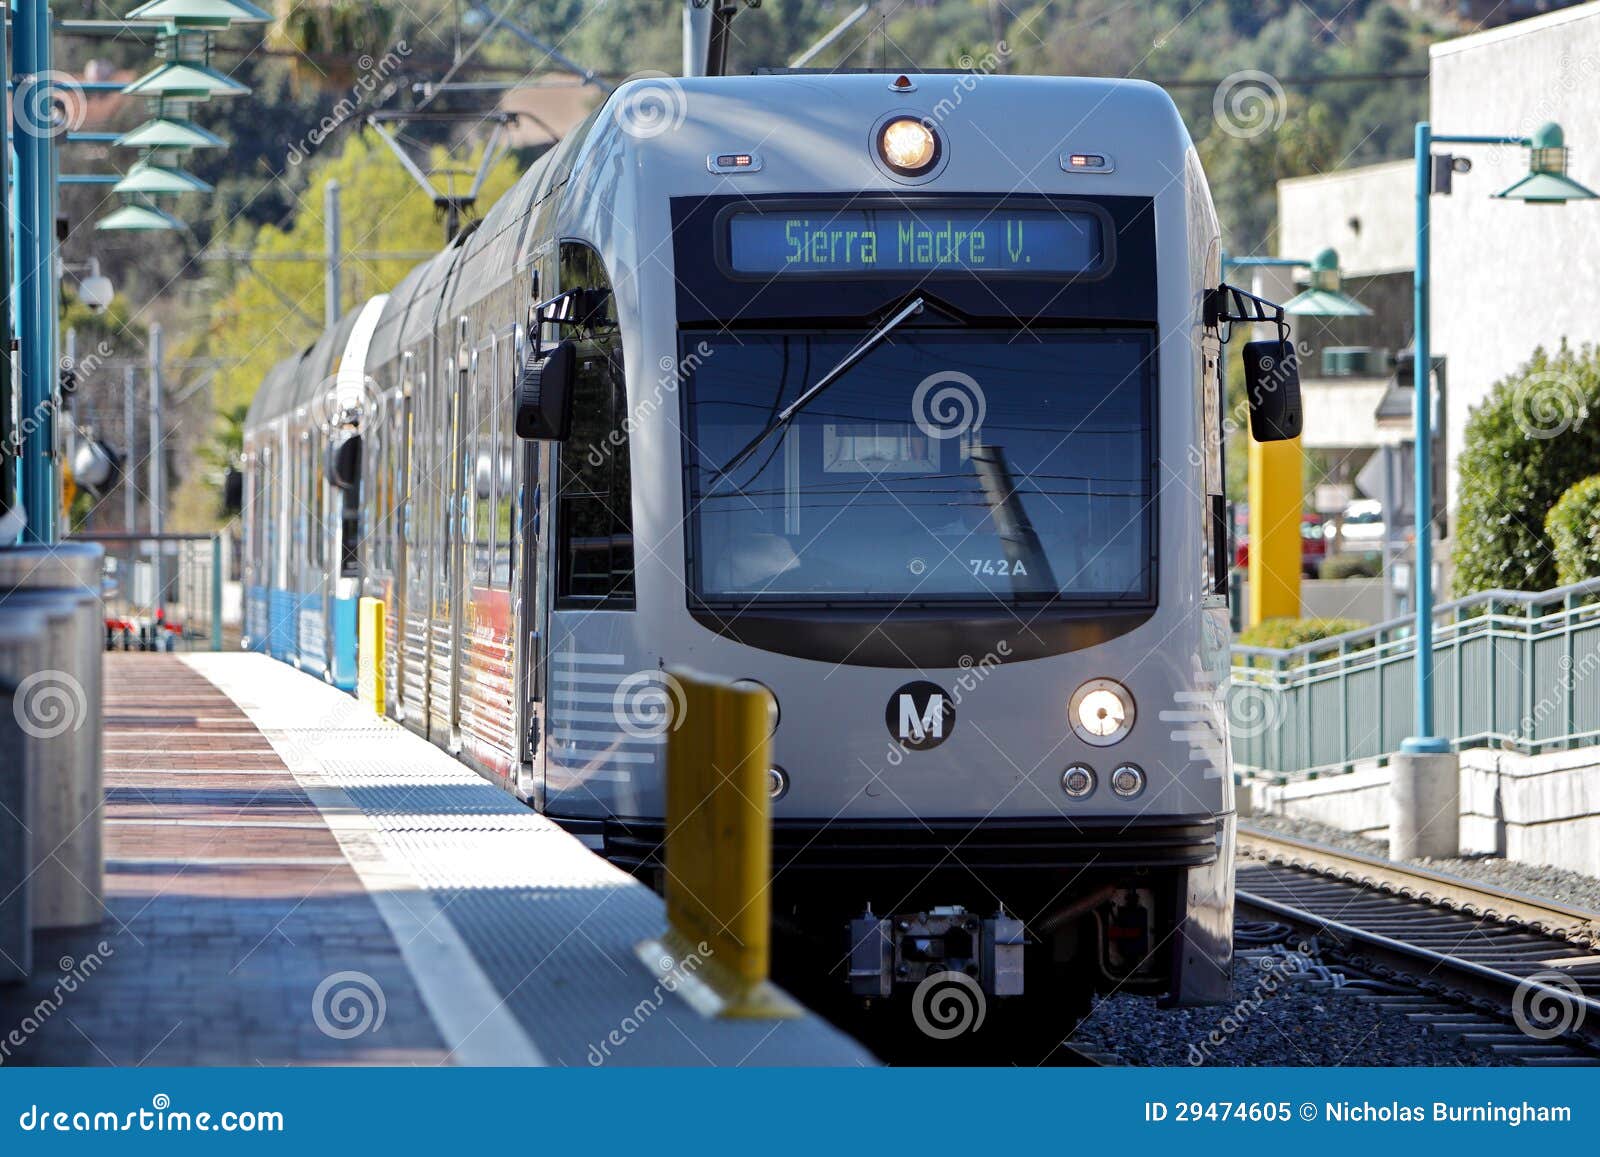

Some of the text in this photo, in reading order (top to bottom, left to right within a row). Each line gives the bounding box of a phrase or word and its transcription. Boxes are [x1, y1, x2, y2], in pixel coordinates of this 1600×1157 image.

[785, 219, 1032, 263] Sierra Madre V.
[969, 559, 1028, 576] 742A
[899, 693, 943, 738] M
